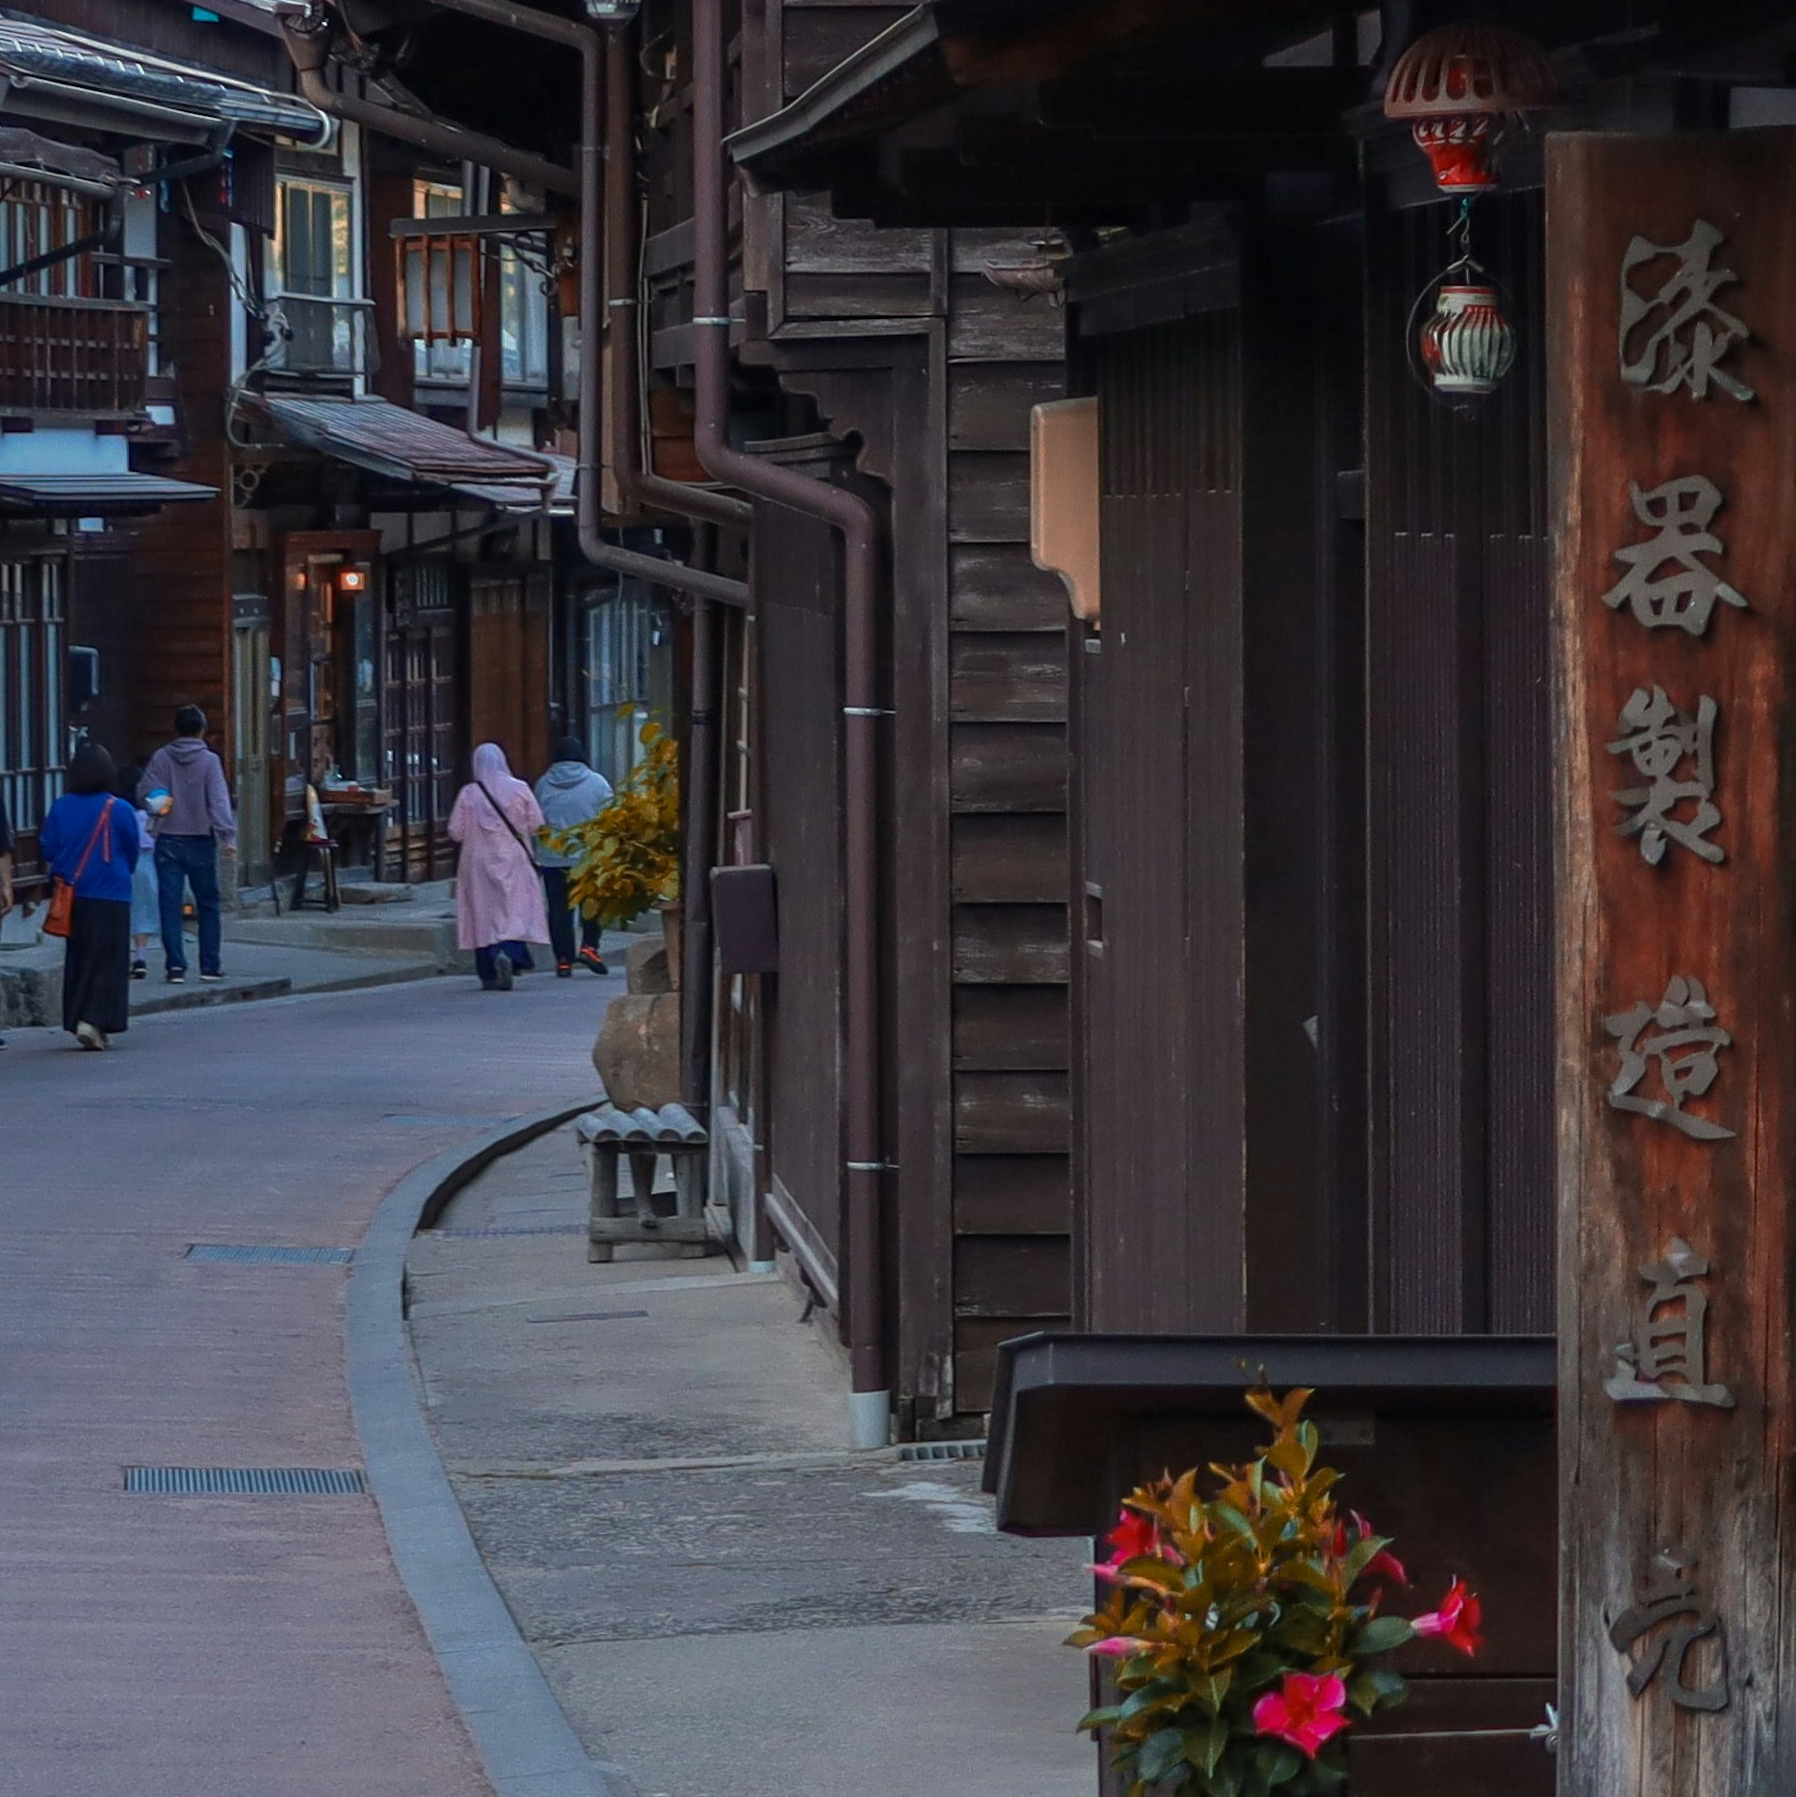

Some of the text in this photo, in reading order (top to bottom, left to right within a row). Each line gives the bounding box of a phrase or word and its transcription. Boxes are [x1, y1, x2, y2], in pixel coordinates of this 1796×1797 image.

[1601, 218, 1757, 1714] 漆器製造直売
